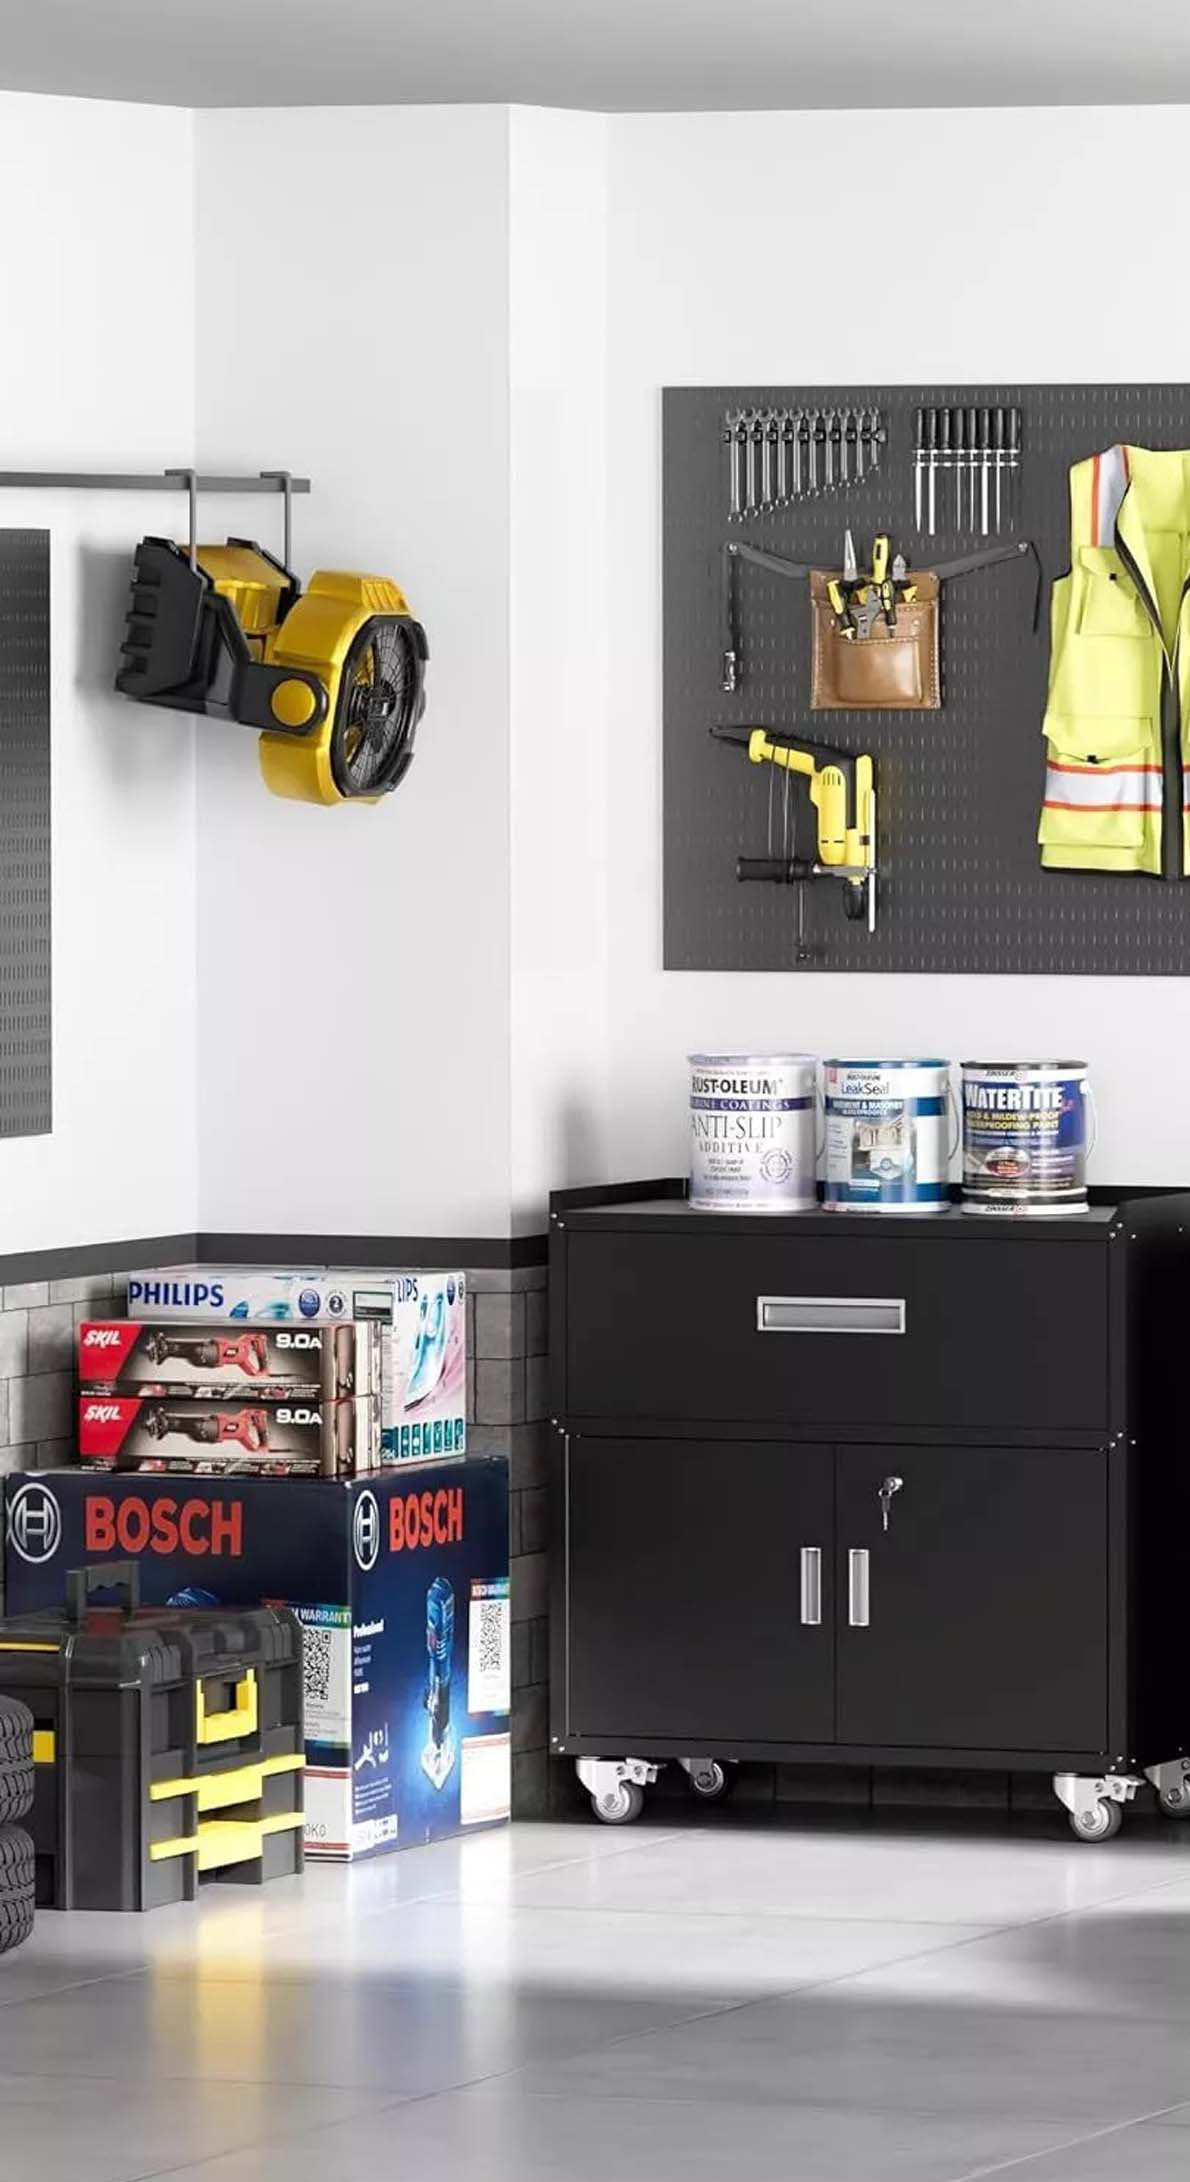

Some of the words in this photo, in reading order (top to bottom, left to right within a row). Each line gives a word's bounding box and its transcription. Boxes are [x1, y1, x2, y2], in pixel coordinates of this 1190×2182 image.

[841, 1082, 889, 1095] LeakSeal
[720, 1099, 790, 1111] COATINGS
[692, 1114, 782, 1139] ANTI-SLIP
[699, 1142, 764, 1153] ADDITIVE
[129, 1281, 224, 1307] PHILIPS
[396, 1277, 418, 1302] LIPS
[84, 1330, 121, 1348] SKIL
[275, 1333, 322, 1349] 9.0A
[84, 1404, 122, 1423] SKIL
[276, 1408, 323, 1425] 9.0A
[84, 1496, 244, 1556] BOSCH
[389, 1487, 464, 1552] BOSCH
